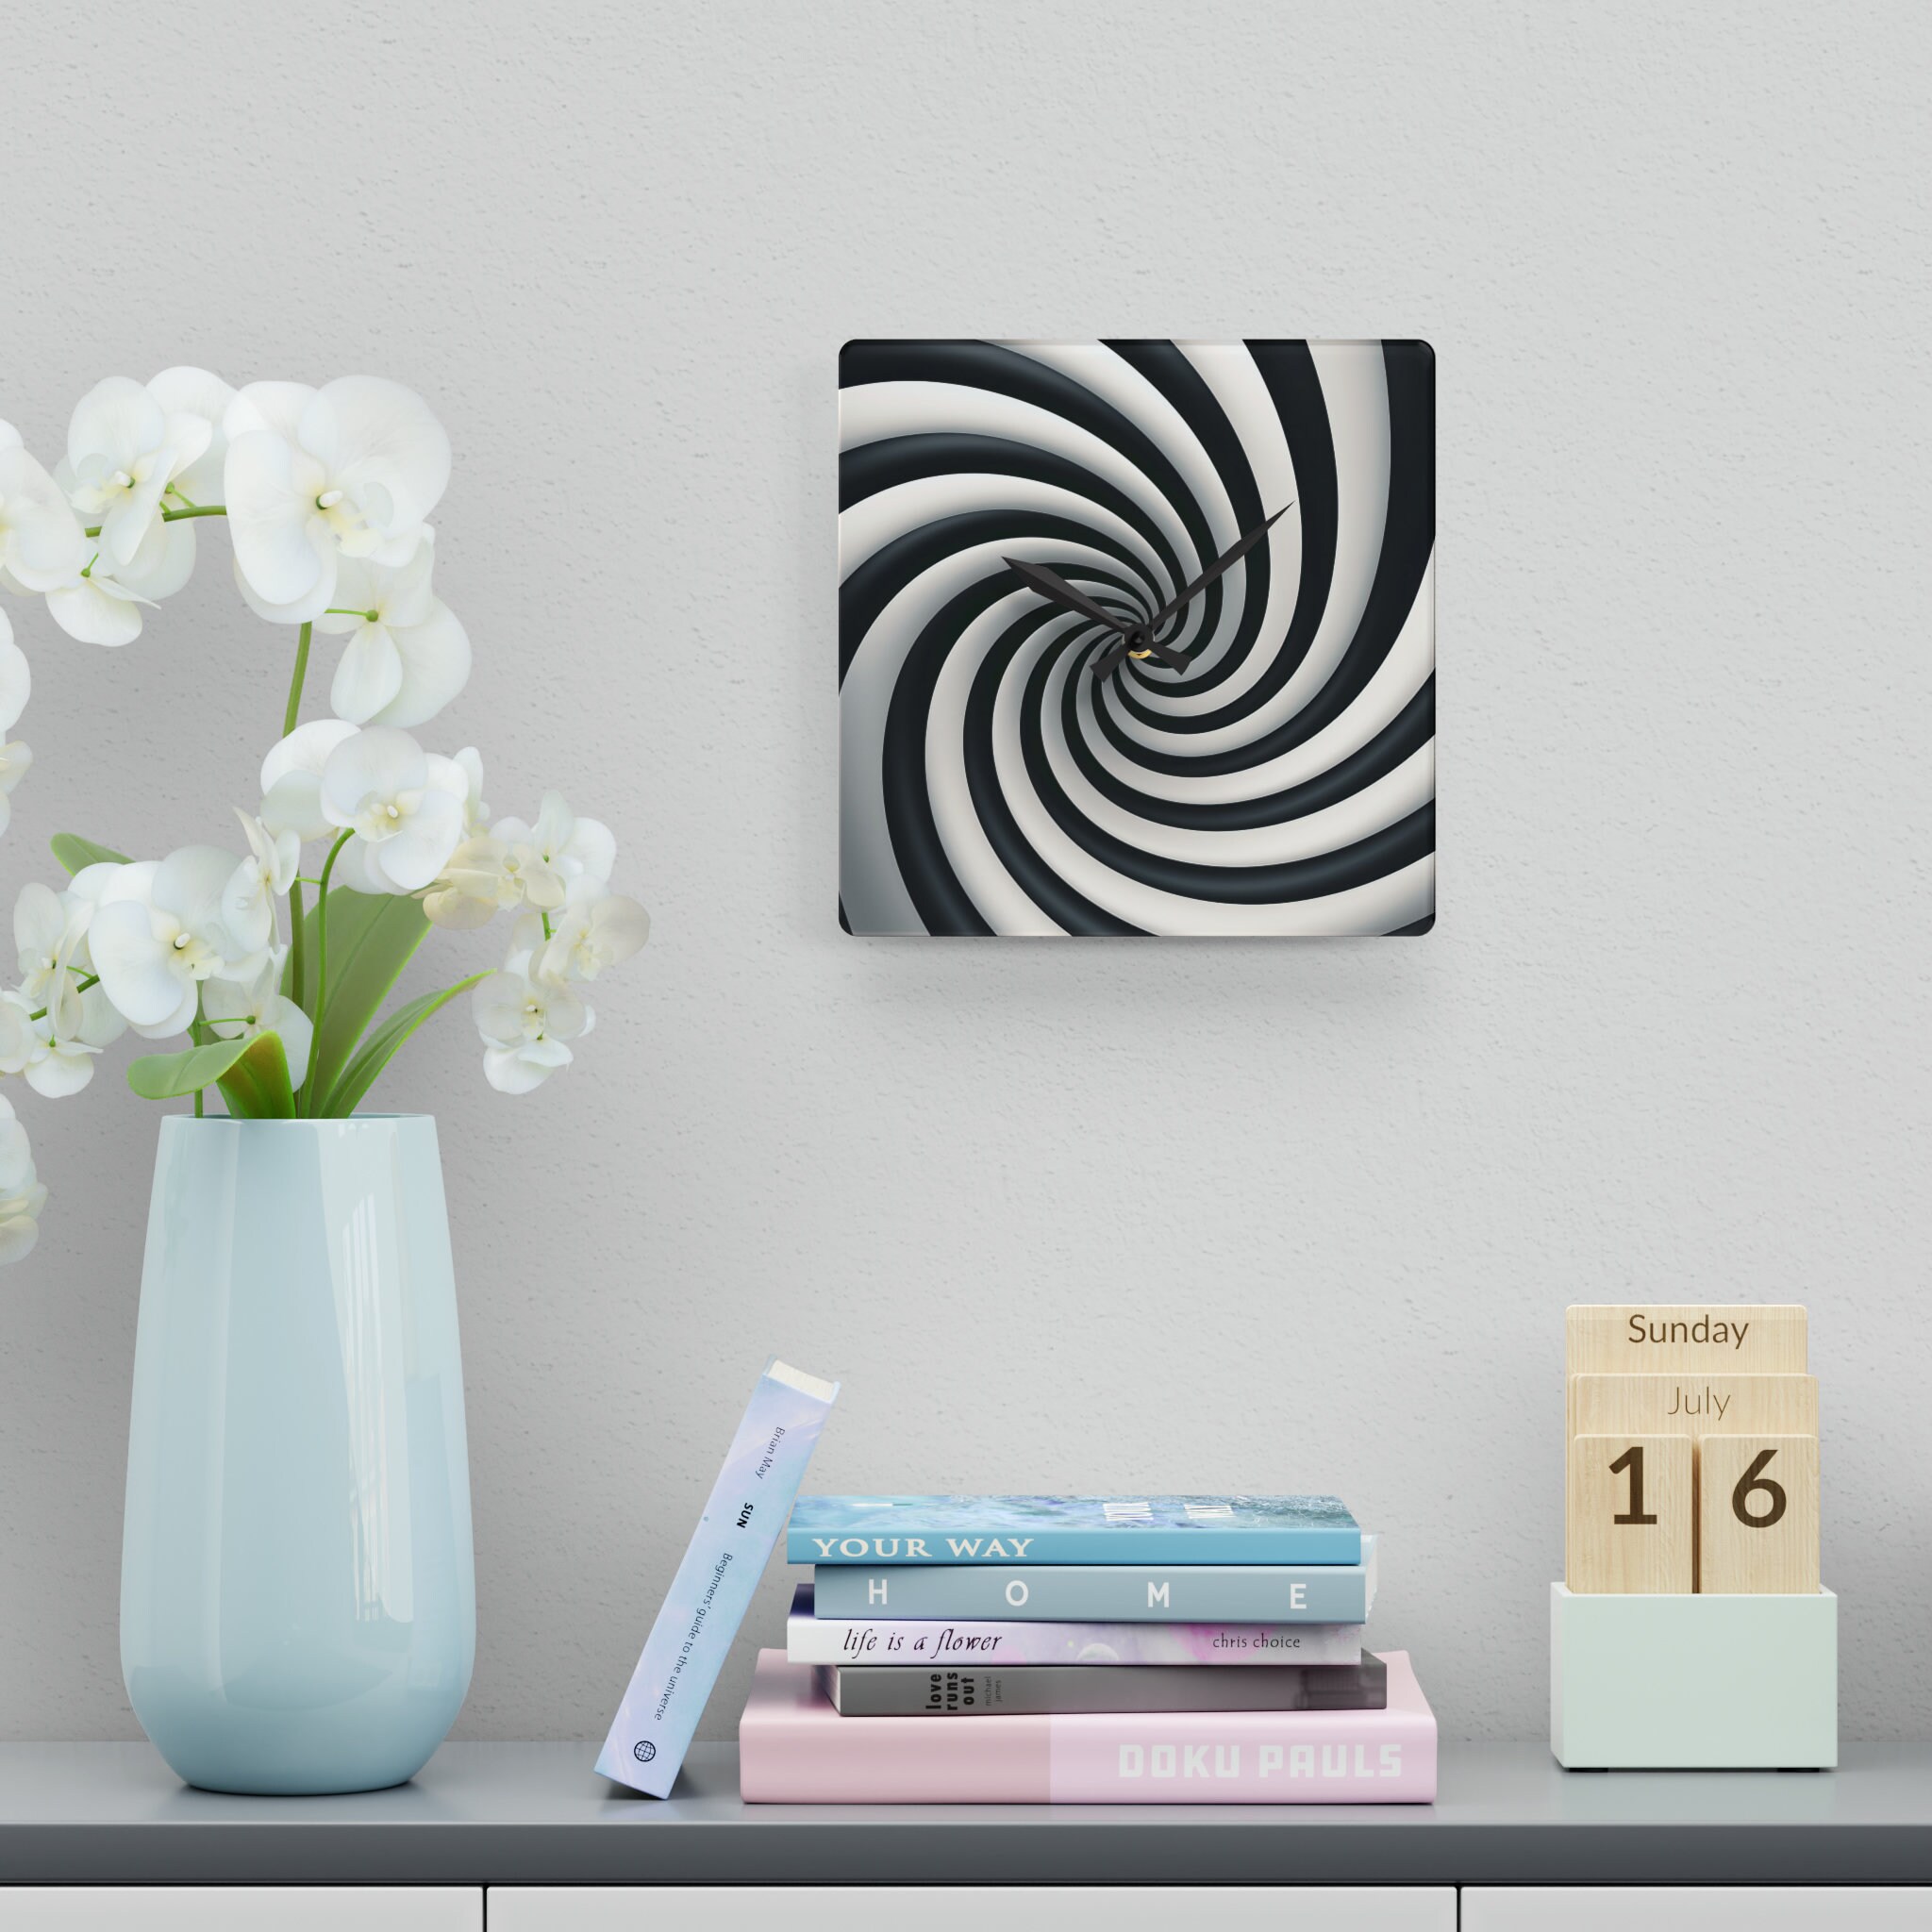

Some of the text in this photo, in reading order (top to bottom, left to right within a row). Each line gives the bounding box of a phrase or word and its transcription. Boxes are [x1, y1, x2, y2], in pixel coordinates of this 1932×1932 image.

[1627, 1314, 1749, 1350] Sunday
[1667, 1386, 1731, 1422] July
[755, 1426, 786, 1479] Brian May
[736, 1502, 754, 1529] SUN
[811, 1538, 1035, 1557] YOUR WAY
[688, 1607, 707, 1640] guide
[682, 1641, 693, 1653] to
[842, 1628, 1003, 1659] life is a flower
[1212, 1633, 1301, 1649] chris choice
[673, 1656, 688, 1674] the
[654, 1675, 678, 1721] universe
[925, 1674, 942, 1709] love
[946, 1672, 958, 1710] runs
[961, 1677, 974, 1706] out
[984, 1675, 992, 1707] michael
[1118, 1744, 1403, 1778] DOKU PAULS
